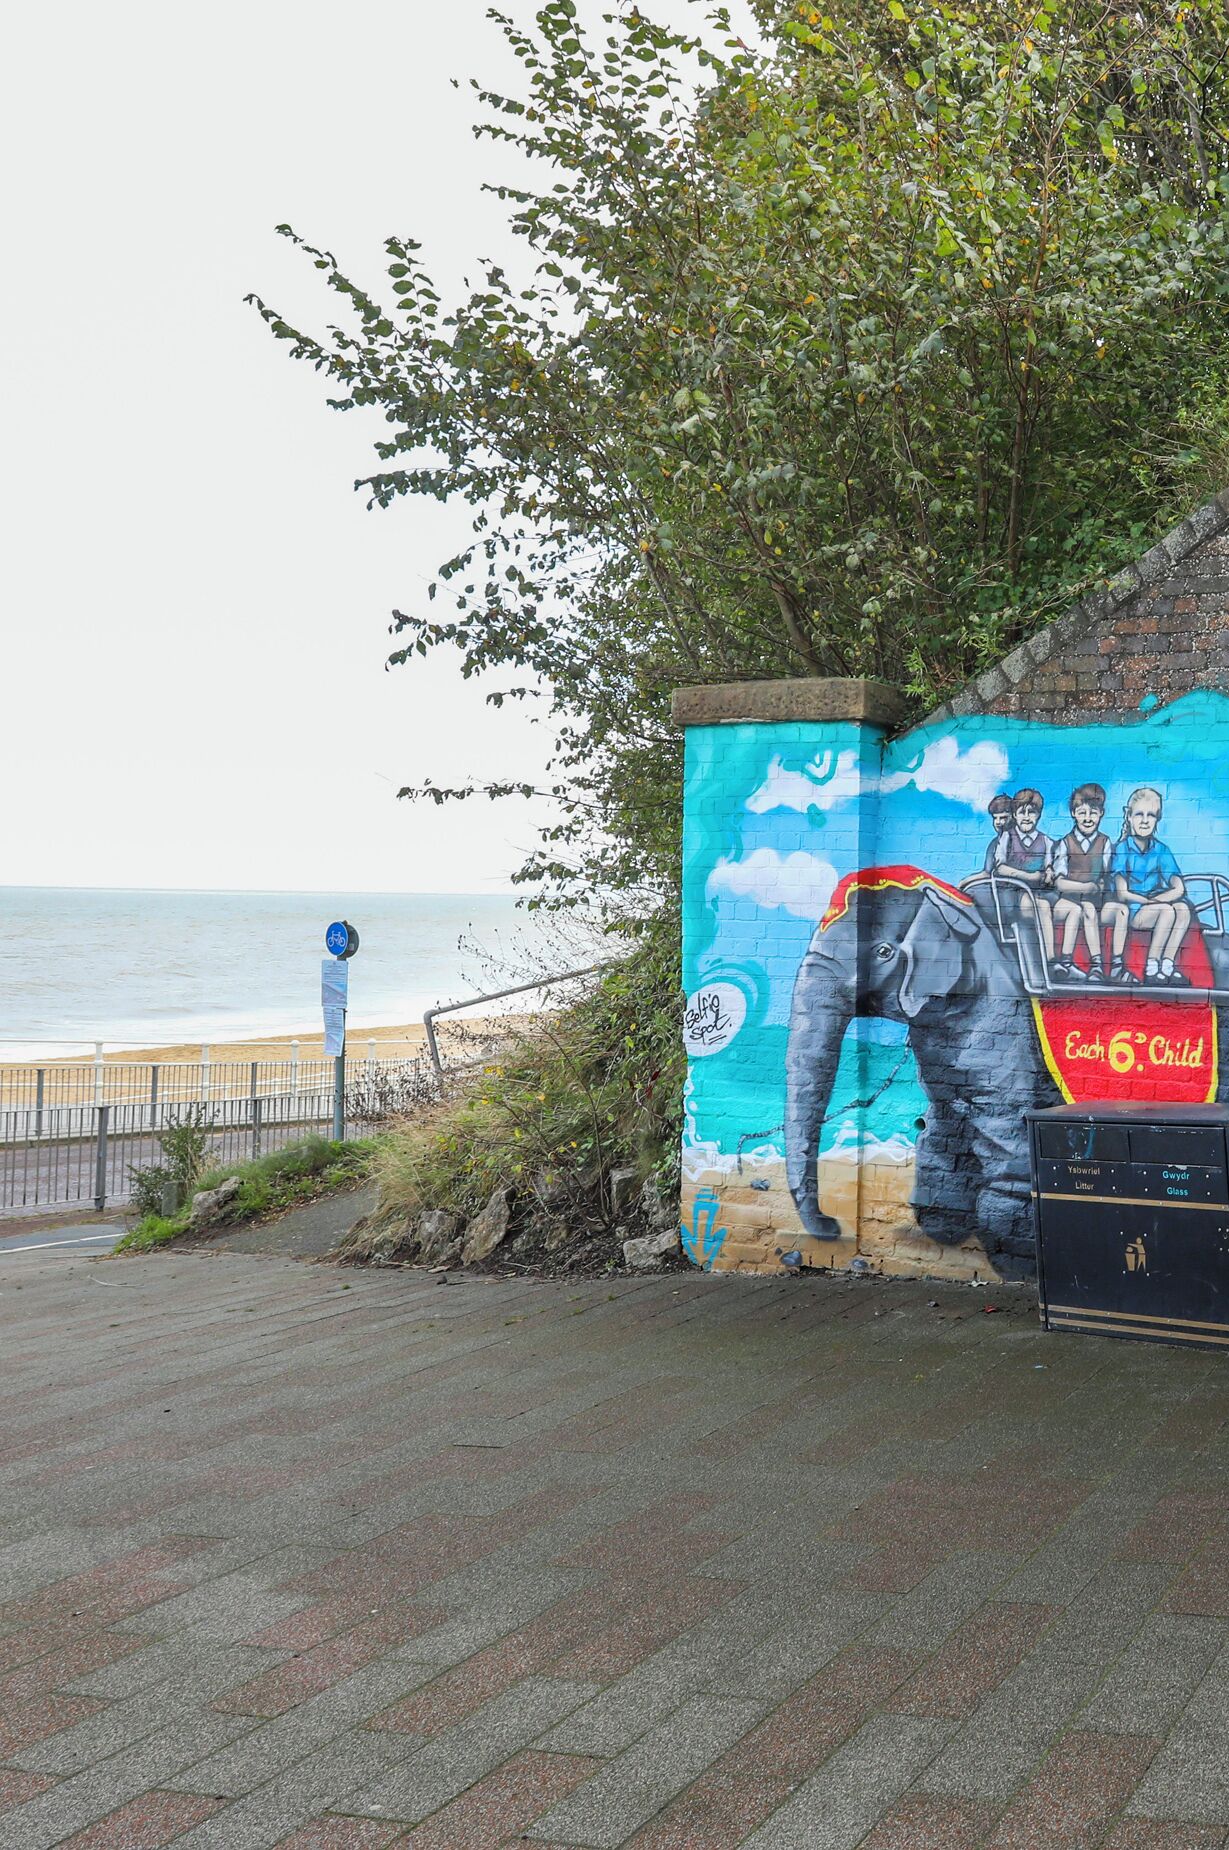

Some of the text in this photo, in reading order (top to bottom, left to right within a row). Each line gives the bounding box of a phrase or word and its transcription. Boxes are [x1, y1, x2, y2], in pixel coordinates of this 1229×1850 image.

[1065, 1030, 1105, 1061] Each
[1148, 1035, 1204, 1068] Child
[1067, 1165, 1101, 1175] Ysbwriel
[1162, 1170, 1190, 1181] Gwydr
[1075, 1181, 1095, 1190] Litter
[1166, 1186, 1189, 1196] Glass
